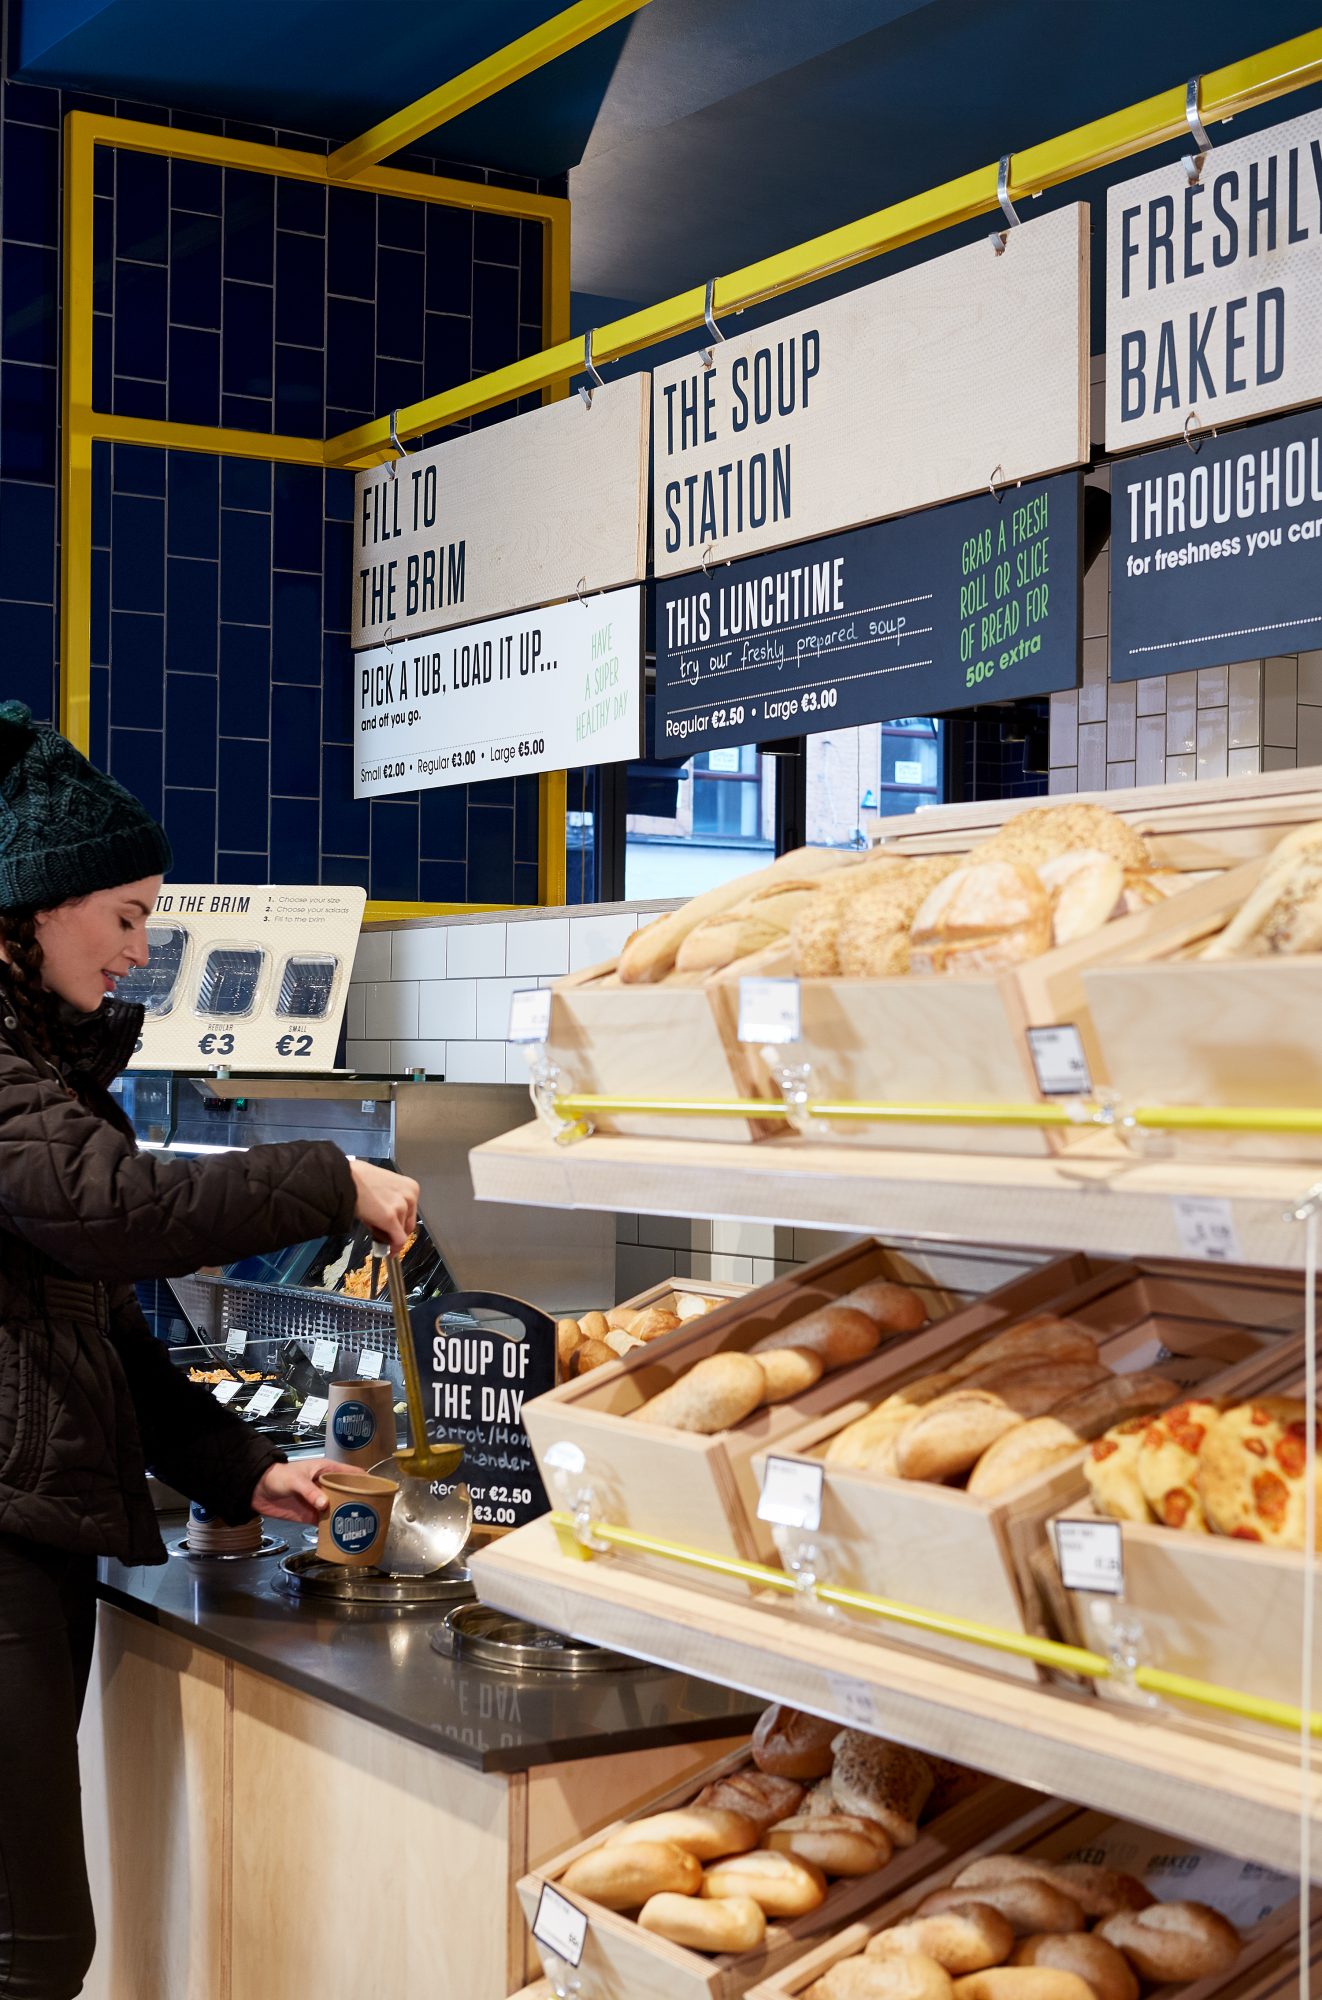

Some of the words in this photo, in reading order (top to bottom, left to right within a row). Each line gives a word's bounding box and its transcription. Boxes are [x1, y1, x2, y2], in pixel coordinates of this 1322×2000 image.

[1121, 286, 1285, 424] BAKED
[663, 367, 717, 456] THE
[732, 329, 820, 433] SOUP
[362, 478, 401, 547] FILL
[412, 464, 437, 531] TO
[665, 443, 791, 554] STATION
[1127, 437, 1322, 543] THROUGHOU
[962, 528, 992, 576] GRAB
[997, 519, 1007, 556] A
[1012, 492, 1048, 547] FRESH
[1126, 555, 1151, 577] for
[1155, 537, 1241, 571] freshness
[1246, 527, 1282, 556] you
[360, 560, 398, 627] THE
[406, 540, 466, 616] BRIM
[666, 591, 711, 649] THIS
[719, 557, 845, 637] LUNCHTIME
[960, 573, 989, 621] ROLL
[994, 561, 1011, 601] OR
[1016, 536, 1050, 588] SLICE
[591, 622, 613, 662] HAVE
[960, 623, 976, 662] OF
[981, 600, 1020, 652] BREAD
[1026, 583, 1049, 628] FOR
[361, 663, 394, 709] PICK
[399, 660, 408, 701] A
[414, 652, 446, 695] TUB,
[453, 640, 492, 690] LOAD
[499, 636, 513, 680] IT
[520, 629, 558, 676] UP...
[680, 655, 699, 686] try
[710, 652, 733, 671] our
[740, 640, 784, 671] freshly
[797, 622, 858, 668] prepared
[869, 616, 907, 647] soup
[965, 659, 995, 688] 50c
[999, 634, 1041, 671] extra
[585, 672, 591, 702] A
[594, 656, 619, 696] SUPER
[361, 714, 377, 731] and
[379, 712, 390, 727] off
[391, 712, 406, 729] you
[407, 709, 422, 726] go.
[576, 696, 611, 743] HEALTHY
[614, 689, 629, 721] DAY
[666, 715, 709, 739] Regular
[711, 706, 745, 729] €2.50
[764, 698, 798, 721] Large
[801, 688, 837, 712] €3.00
[360, 765, 382, 784] Small
[383, 762, 405, 779] €2.00
[418, 756, 450, 775] Regular
[451, 750, 476, 768] €3.00
[490, 746, 516, 764] Large
[518, 738, 545, 758] €5.00
[156, 896, 173, 912] TO
[179, 896, 206, 912] THE
[210, 896, 251, 913] BRIM
[197, 1033, 235, 1055] €3
[207, 1024, 234, 1032] REGULAR
[275, 1034, 314, 1057] €2
[288, 1025, 308, 1033] SMALL
[432, 1336, 494, 1376] SOUP
[502, 1342, 530, 1379] OF
[432, 1382, 472, 1421] THE
[481, 1386, 524, 1425] DAY
[474, 1505, 516, 1524] €3.00
[489, 1485, 532, 1504] €2.50
